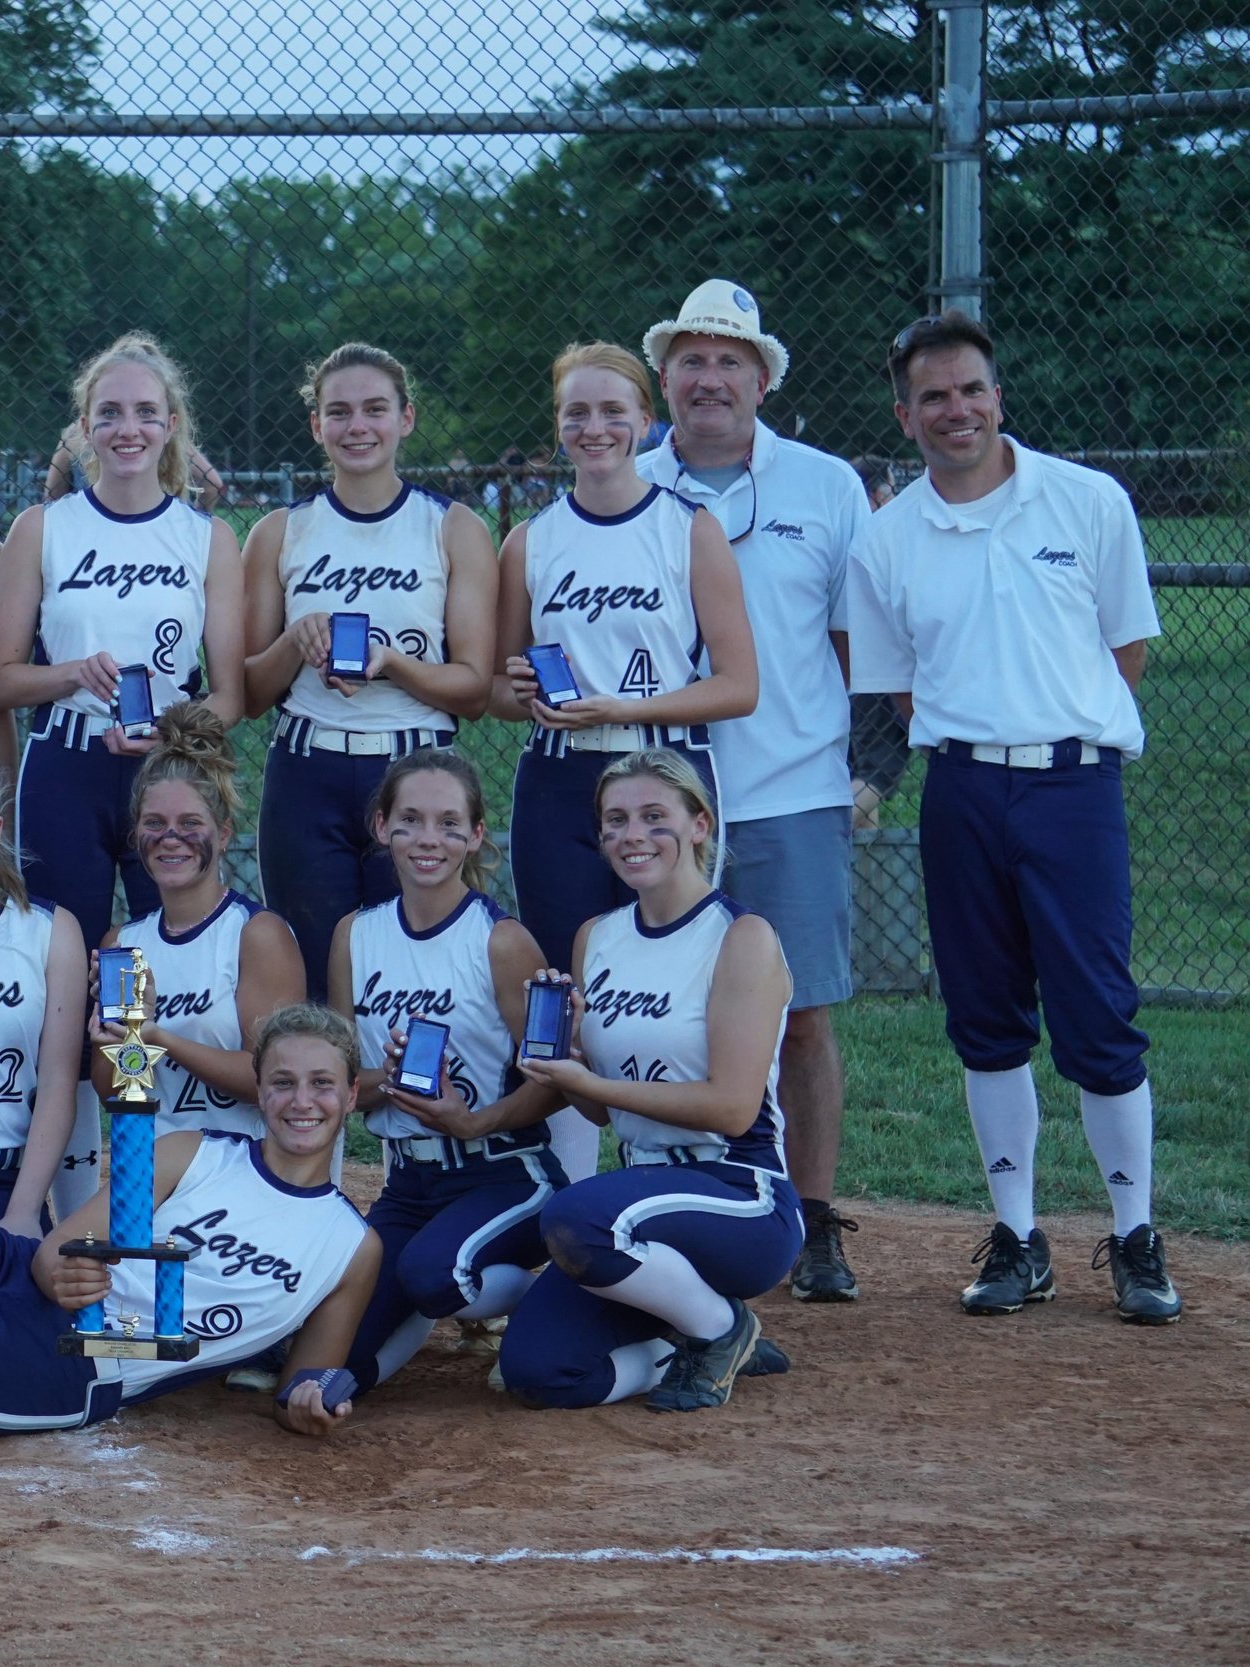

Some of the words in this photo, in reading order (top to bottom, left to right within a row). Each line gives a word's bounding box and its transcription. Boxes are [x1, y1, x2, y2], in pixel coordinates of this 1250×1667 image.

[59, 549, 191, 599] Lazers
[293, 553, 422, 604] Lazers
[542, 571, 663, 623] Lazers
[152, 618, 183, 675] 8
[618, 648, 659, 699] 4
[355, 971, 455, 1029] Lazers
[583, 968, 671, 1028] Lazers
[170, 1208, 303, 1293] Lazers
